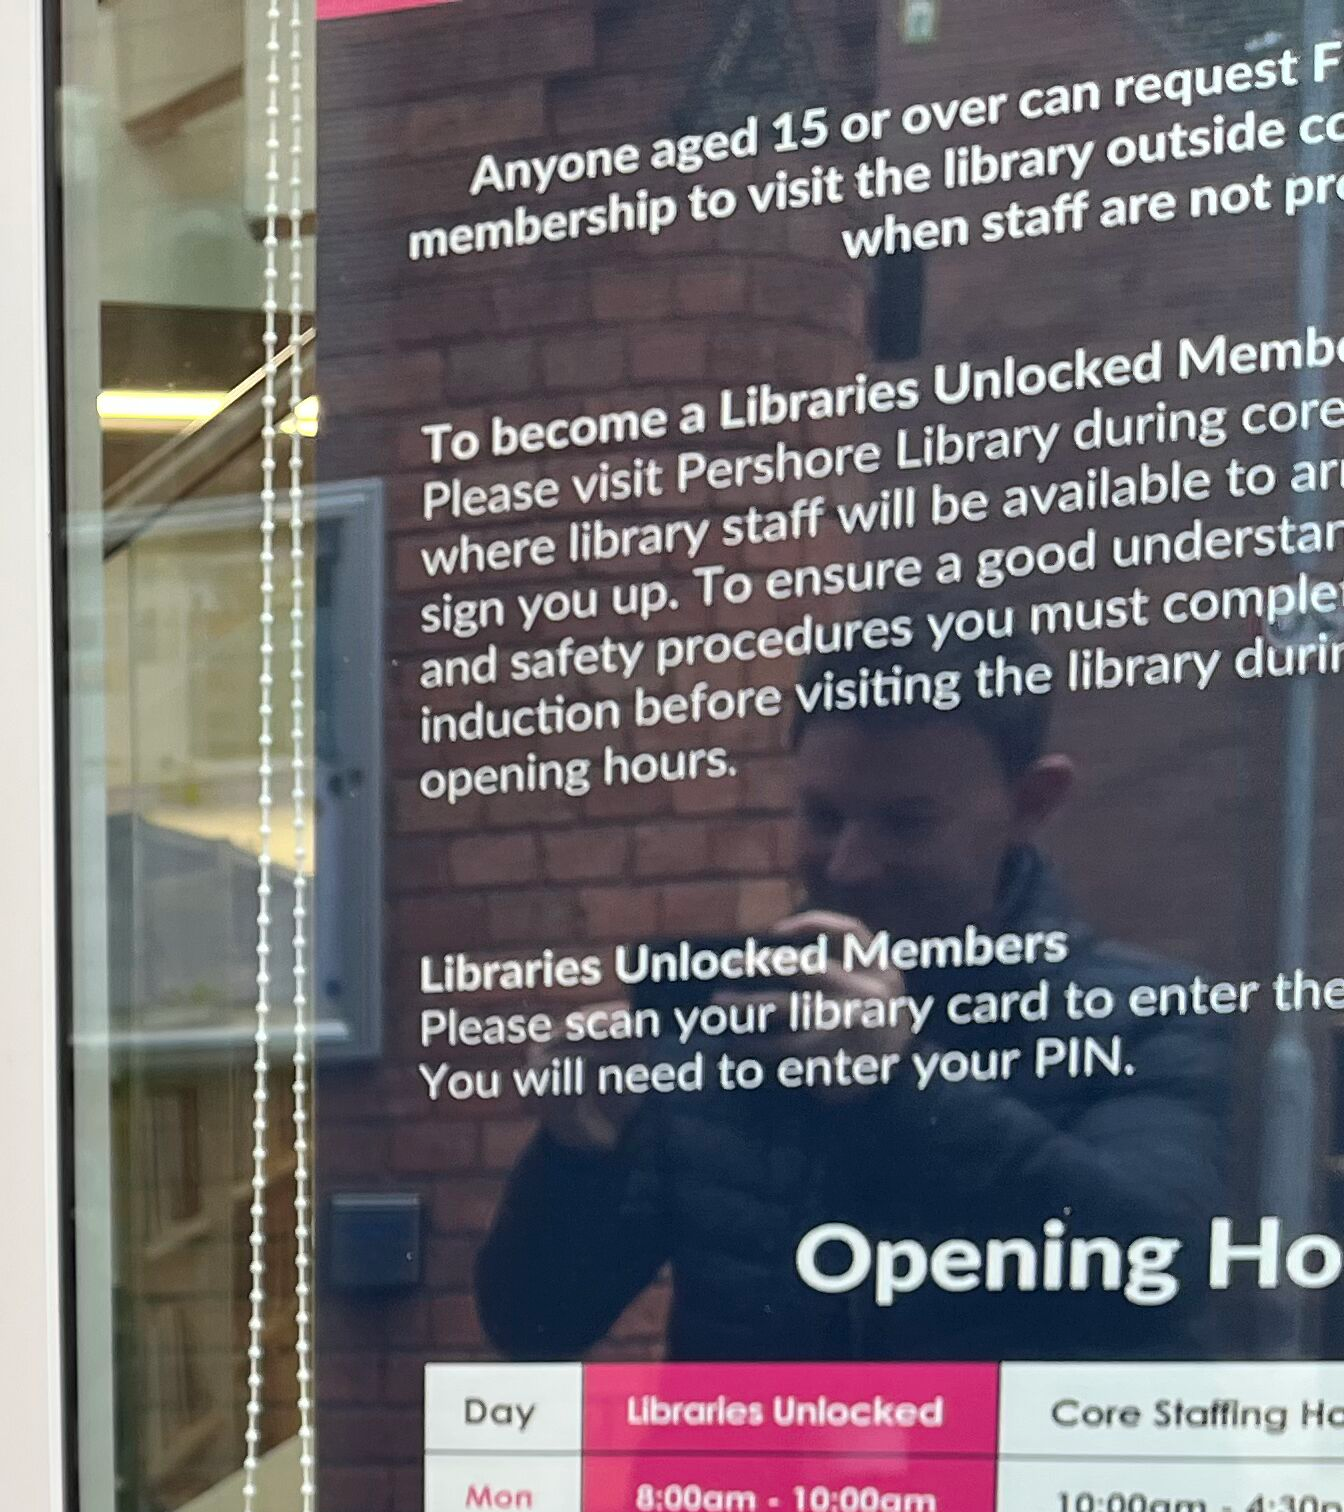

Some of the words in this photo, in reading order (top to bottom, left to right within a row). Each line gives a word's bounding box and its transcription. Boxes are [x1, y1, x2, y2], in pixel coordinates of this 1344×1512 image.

[469, 144, 640, 196] Anyone
[651, 116, 758, 173] aged
[772, 107, 828, 152] 15
[841, 108, 892, 142] or
[902, 93, 1008, 134] over
[1019, 81, 1100, 119] can
[1115, 50, 1298, 107] request
[409, 189, 677, 260] membership
[688, 185, 736, 221] to
[747, 165, 844, 213] visit
[854, 157, 931, 199] the
[945, 141, 1096, 188] library
[1107, 110, 1285, 166] outside
[841, 214, 969, 259] when
[982, 189, 1089, 242] staff
[1100, 191, 1176, 227] are
[1191, 174, 1271, 217] not
[421, 423, 479, 463] To
[492, 408, 668, 456] become
[680, 403, 705, 434] a
[720, 373, 919, 429] Libraries
[935, 340, 1162, 404] Unlocked
[424, 478, 559, 521] Please
[572, 458, 663, 503] visit
[678, 441, 881, 493] Pershore
[897, 423, 1061, 469] Library
[1074, 407, 1228, 450] during
[421, 534, 556, 576] where
[570, 519, 710, 562] library
[723, 496, 825, 546] staff
[837, 486, 916, 534] will
[932, 484, 989, 525] be
[1003, 460, 1211, 518] available
[1226, 459, 1276, 497] to
[421, 593, 504, 637] sign
[518, 588, 597, 631] you
[613, 581, 678, 621] up.
[692, 565, 753, 606] To
[766, 556, 922, 599] ensure
[936, 553, 962, 584] a
[976, 528, 1096, 588] good
[420, 644, 497, 688] and
[511, 637, 644, 680] safety
[657, 614, 914, 676] procedures
[927, 607, 1014, 652] you
[1031, 587, 1150, 635] must
[422, 694, 620, 744] induction
[635, 682, 782, 726] before
[794, 665, 962, 712] visiting
[974, 655, 1053, 698] the
[1069, 647, 1221, 691] library
[420, 753, 591, 804] opening
[604, 746, 737, 785] hours.
[421, 949, 602, 993] Libraries
[615, 933, 827, 983] Unlocked
[843, 925, 1069, 972] Members
[421, 1008, 553, 1047] Please
[566, 1004, 660, 1041] scan
[674, 1002, 777, 1044] your
[790, 991, 935, 1034] library
[947, 979, 1049, 1024] card
[1064, 981, 1115, 1019] to
[1129, 976, 1260, 1016] enter
[419, 1062, 502, 1100] You
[513, 1056, 583, 1097] will
[598, 1051, 705, 1094] need
[717, 1053, 764, 1090] to
[777, 1048, 900, 1087] enter
[912, 1048, 1021, 1090] your
[1035, 1035, 1136, 1078] PIN.
[796, 1218, 1182, 1306] Opening
[1209, 1216, 1343, 1289] Ho
[464, 1396, 536, 1433] Day
[627, 1395, 765, 1426] Libraries
[773, 1395, 945, 1428] Unlocked
[1051, 1398, 1142, 1428] Core
[1153, 1398, 1288, 1435] Staffing
[465, 1484, 533, 1510] Mon
[636, 1483, 759, 1512] 8:00am
